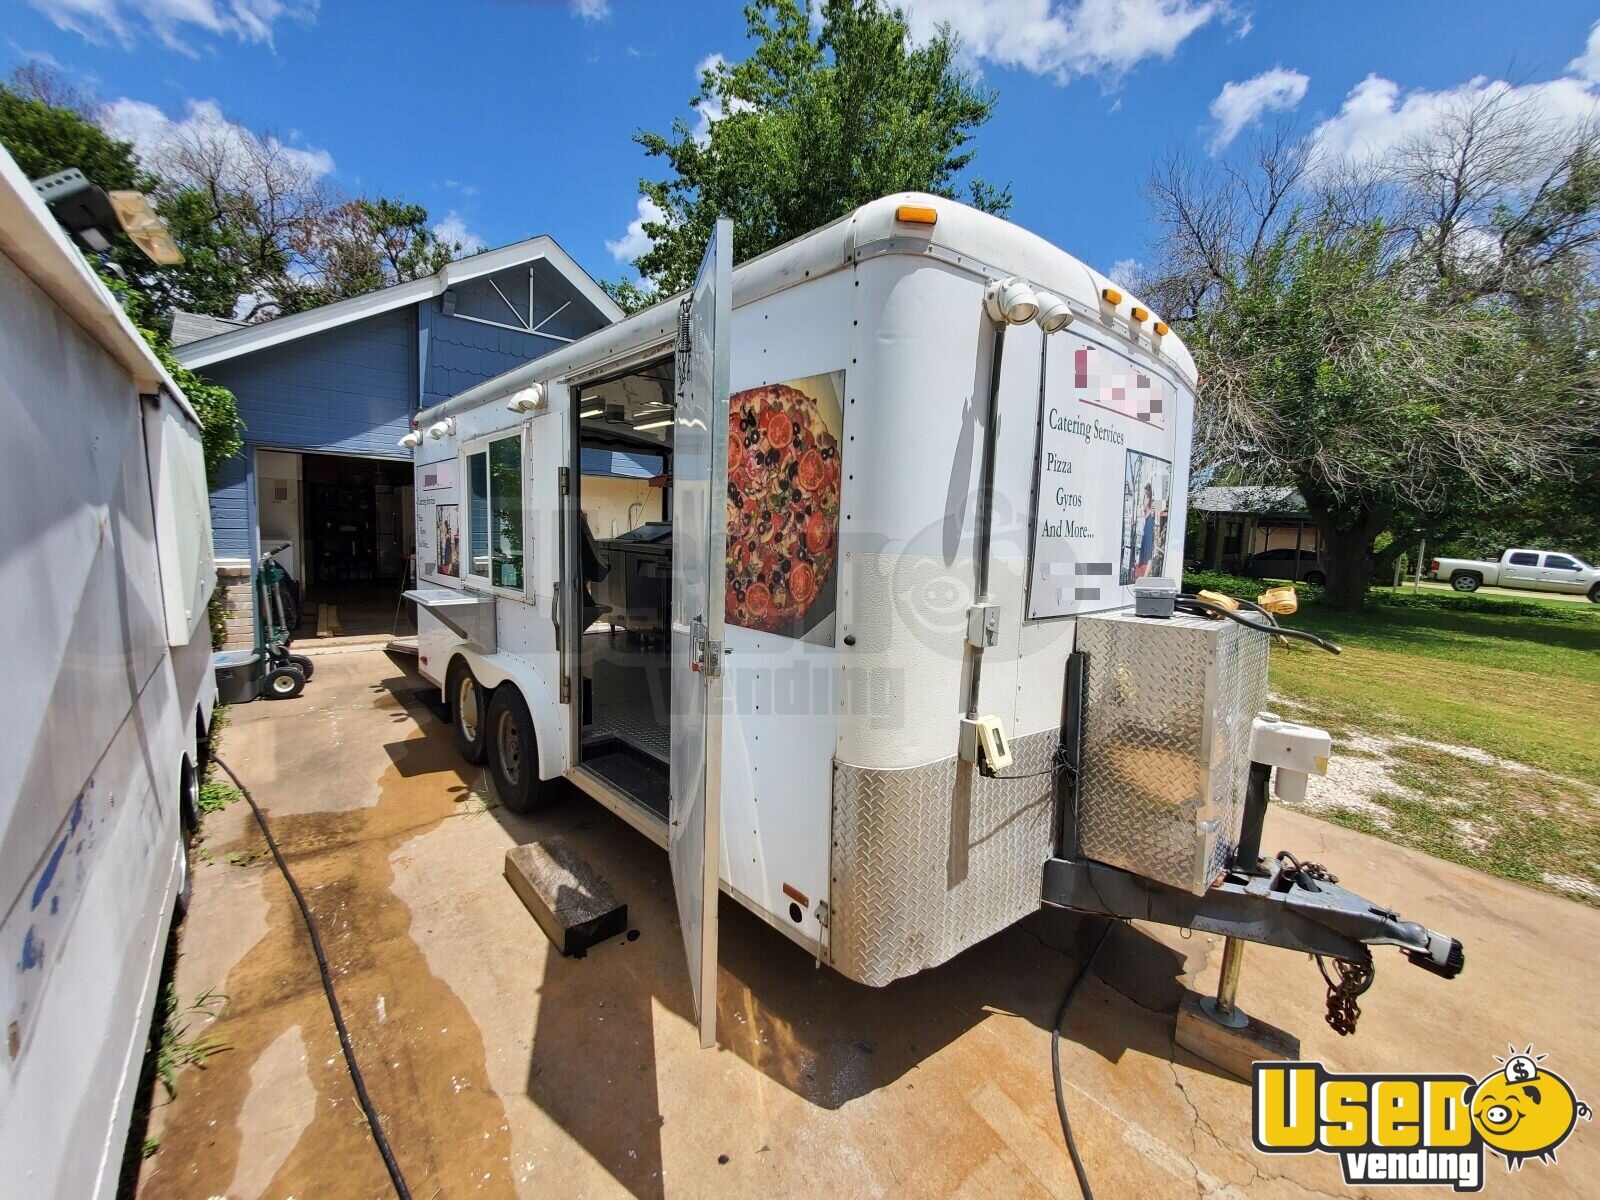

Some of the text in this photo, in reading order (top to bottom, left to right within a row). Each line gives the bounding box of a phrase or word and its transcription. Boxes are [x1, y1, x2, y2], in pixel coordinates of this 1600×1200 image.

[1049, 408, 1125, 445] Catering Services
[1046, 452, 1072, 474] Pizza
[1056, 487, 1082, 512] Gyros
[1041, 518, 1095, 538] And More...
